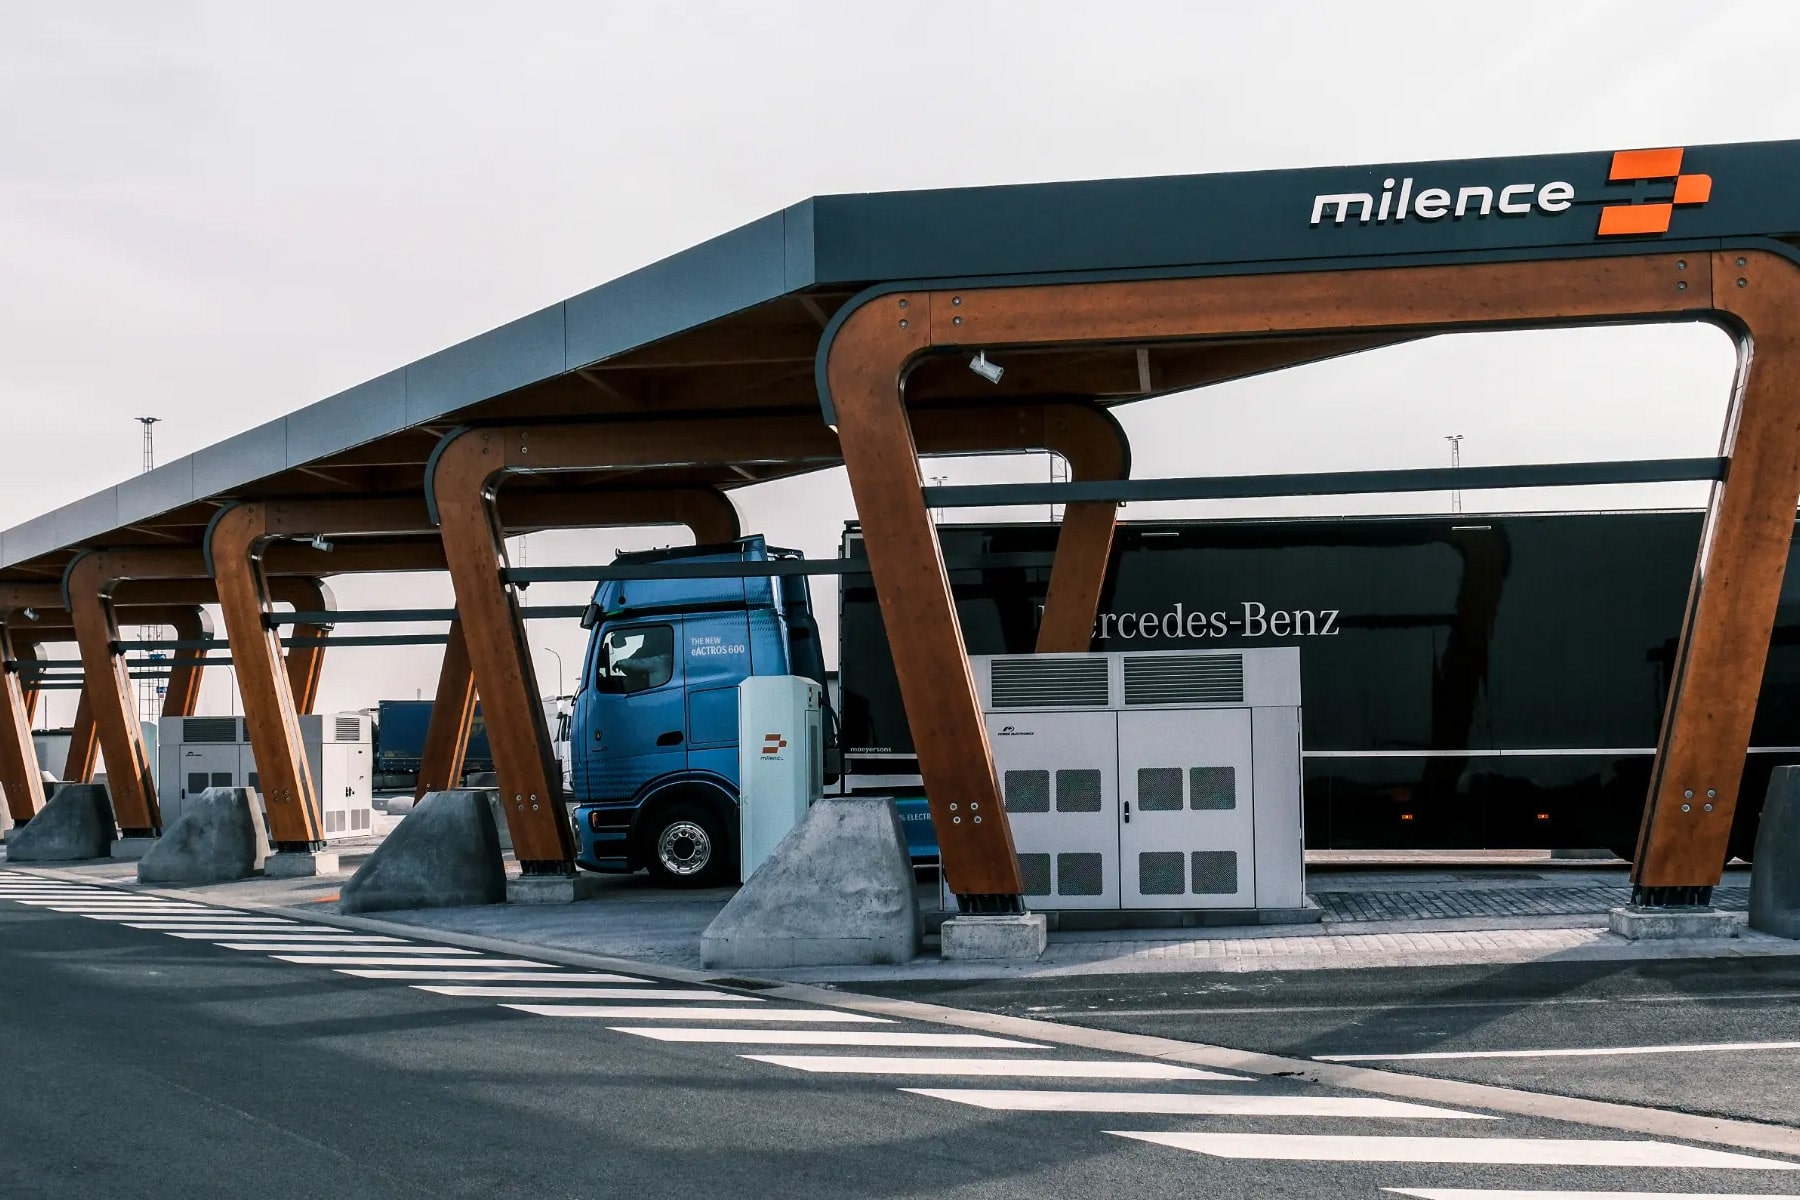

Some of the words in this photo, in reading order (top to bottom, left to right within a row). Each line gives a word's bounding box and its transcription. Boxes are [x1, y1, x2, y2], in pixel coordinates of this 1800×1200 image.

[1310, 177, 1575, 224] milence
[1038, 601, 1341, 639] rcedes-Benz
[691, 637, 703, 645] THE
[705, 636, 721, 645] NEW
[691, 646, 727, 656] eACTROS
[728, 644, 745, 654] 600
